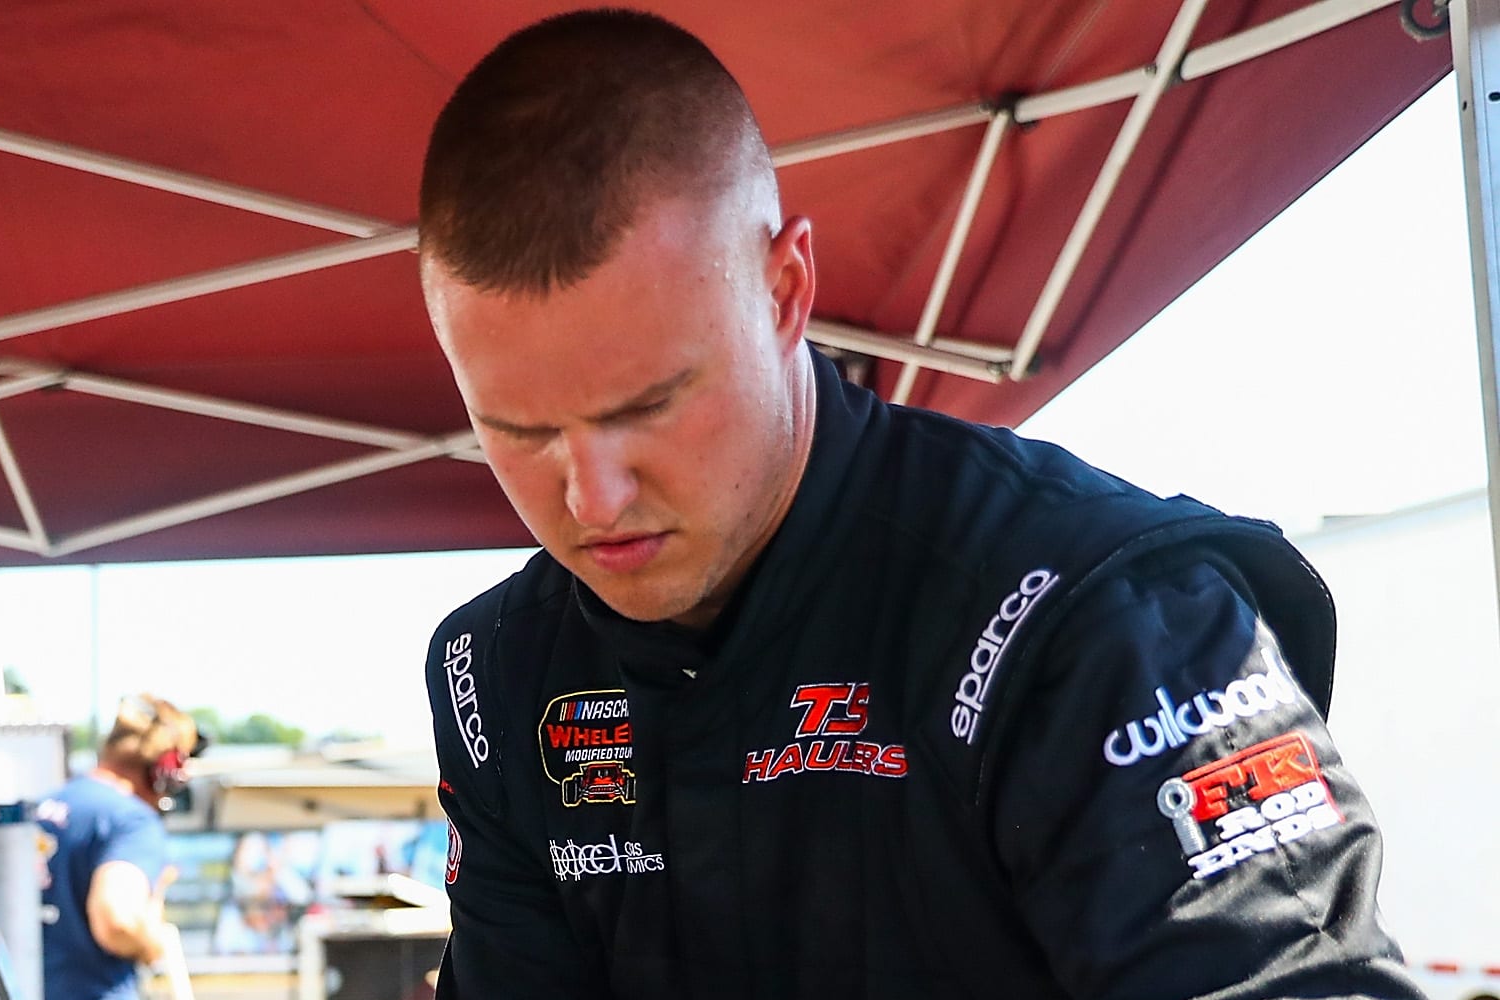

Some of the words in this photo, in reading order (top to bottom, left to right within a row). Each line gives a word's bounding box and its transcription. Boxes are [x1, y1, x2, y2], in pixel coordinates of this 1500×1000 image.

[950, 569, 1059, 744] sparco
[443, 632, 489, 769] sparco
[581, 698, 630, 720] NASCA
[790, 682, 869, 738] TS
[1103, 648, 1297, 767] wilwood
[546, 722, 633, 748] WHELE
[565, 747, 613, 762] MODIFIED
